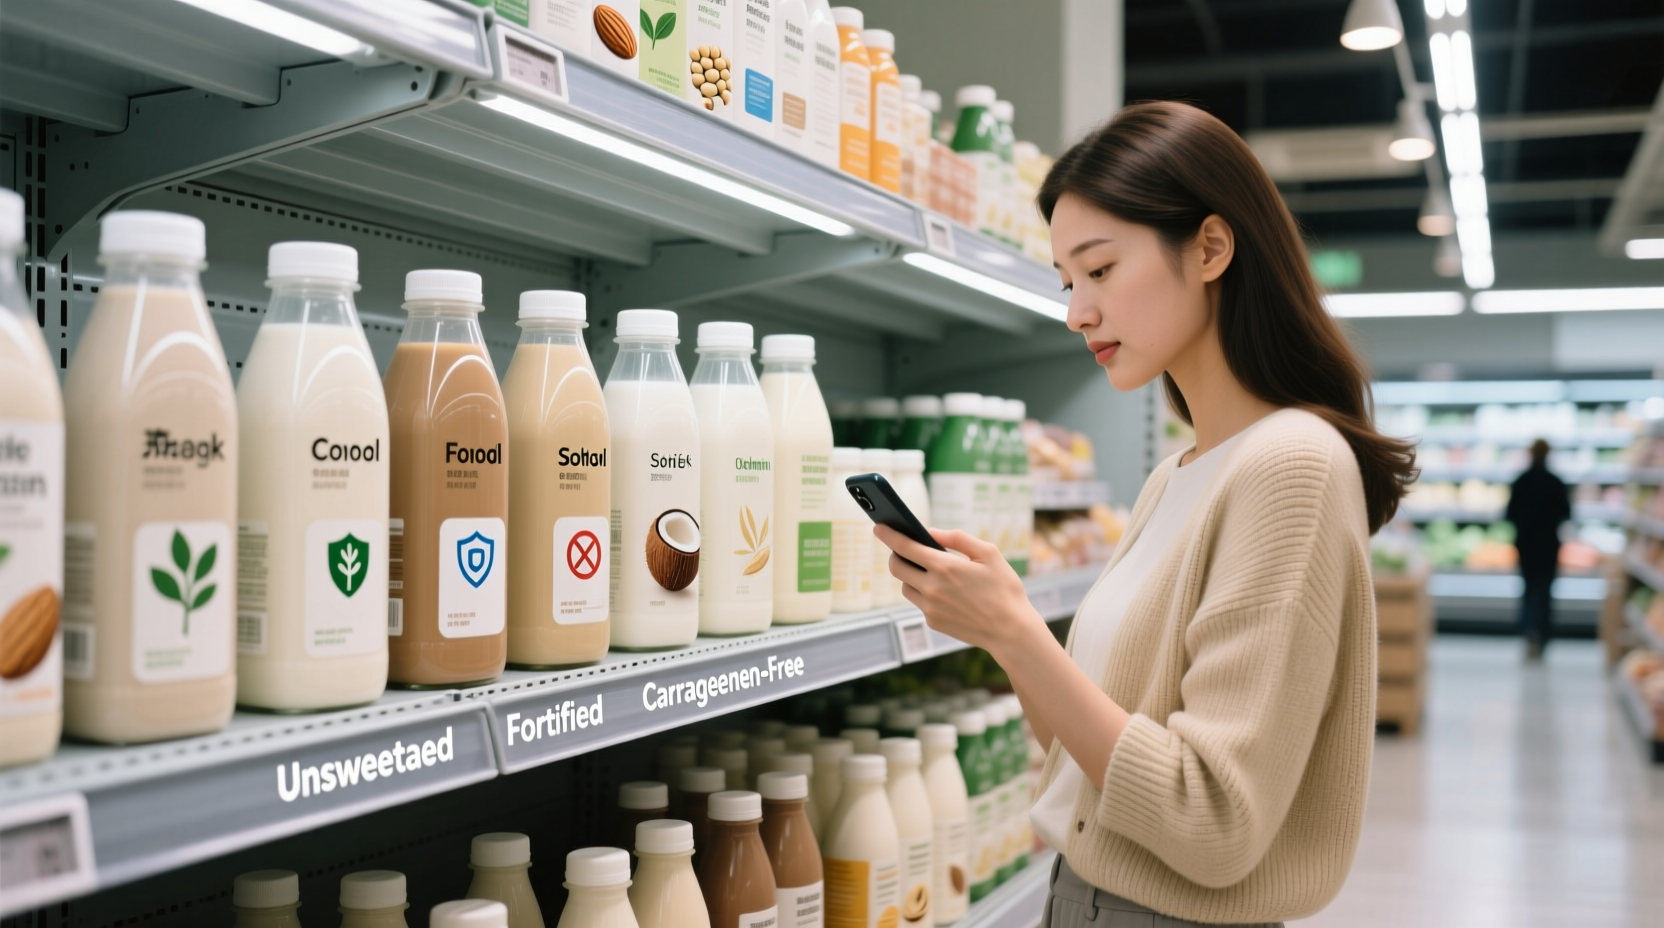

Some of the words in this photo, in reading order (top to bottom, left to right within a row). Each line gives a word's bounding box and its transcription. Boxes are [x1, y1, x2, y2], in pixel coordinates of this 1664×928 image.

[642, 655, 804, 711] Carrageenen-Free
[506, 694, 604, 746] Fortified
[277, 725, 453, 802] Unsweetaed
